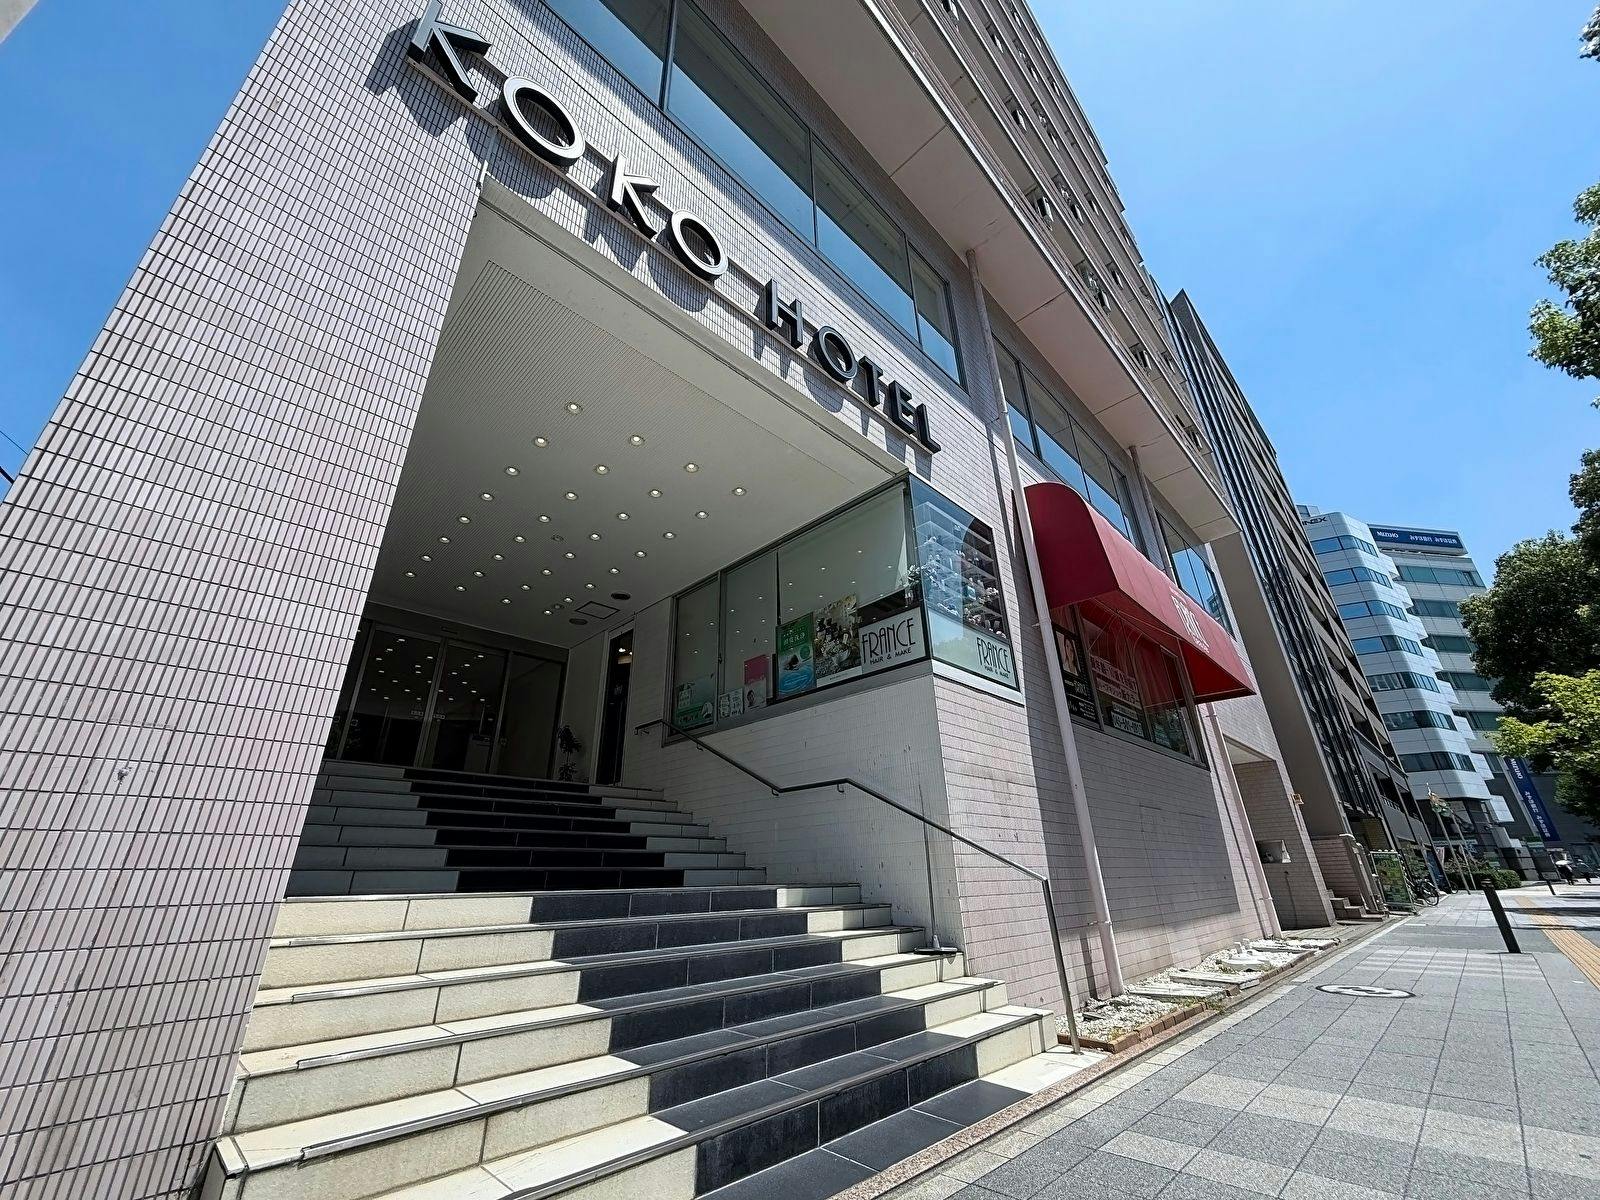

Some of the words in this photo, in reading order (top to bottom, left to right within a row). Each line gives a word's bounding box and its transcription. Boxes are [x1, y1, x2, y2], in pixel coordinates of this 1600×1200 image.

[408, 0, 729, 283] KOKO
[763, 278, 941, 455] HOTEL
[862, 618, 916, 664] FRANCE
[895, 648, 911, 657] MAKE
[977, 637, 1011, 673] FRANCE
